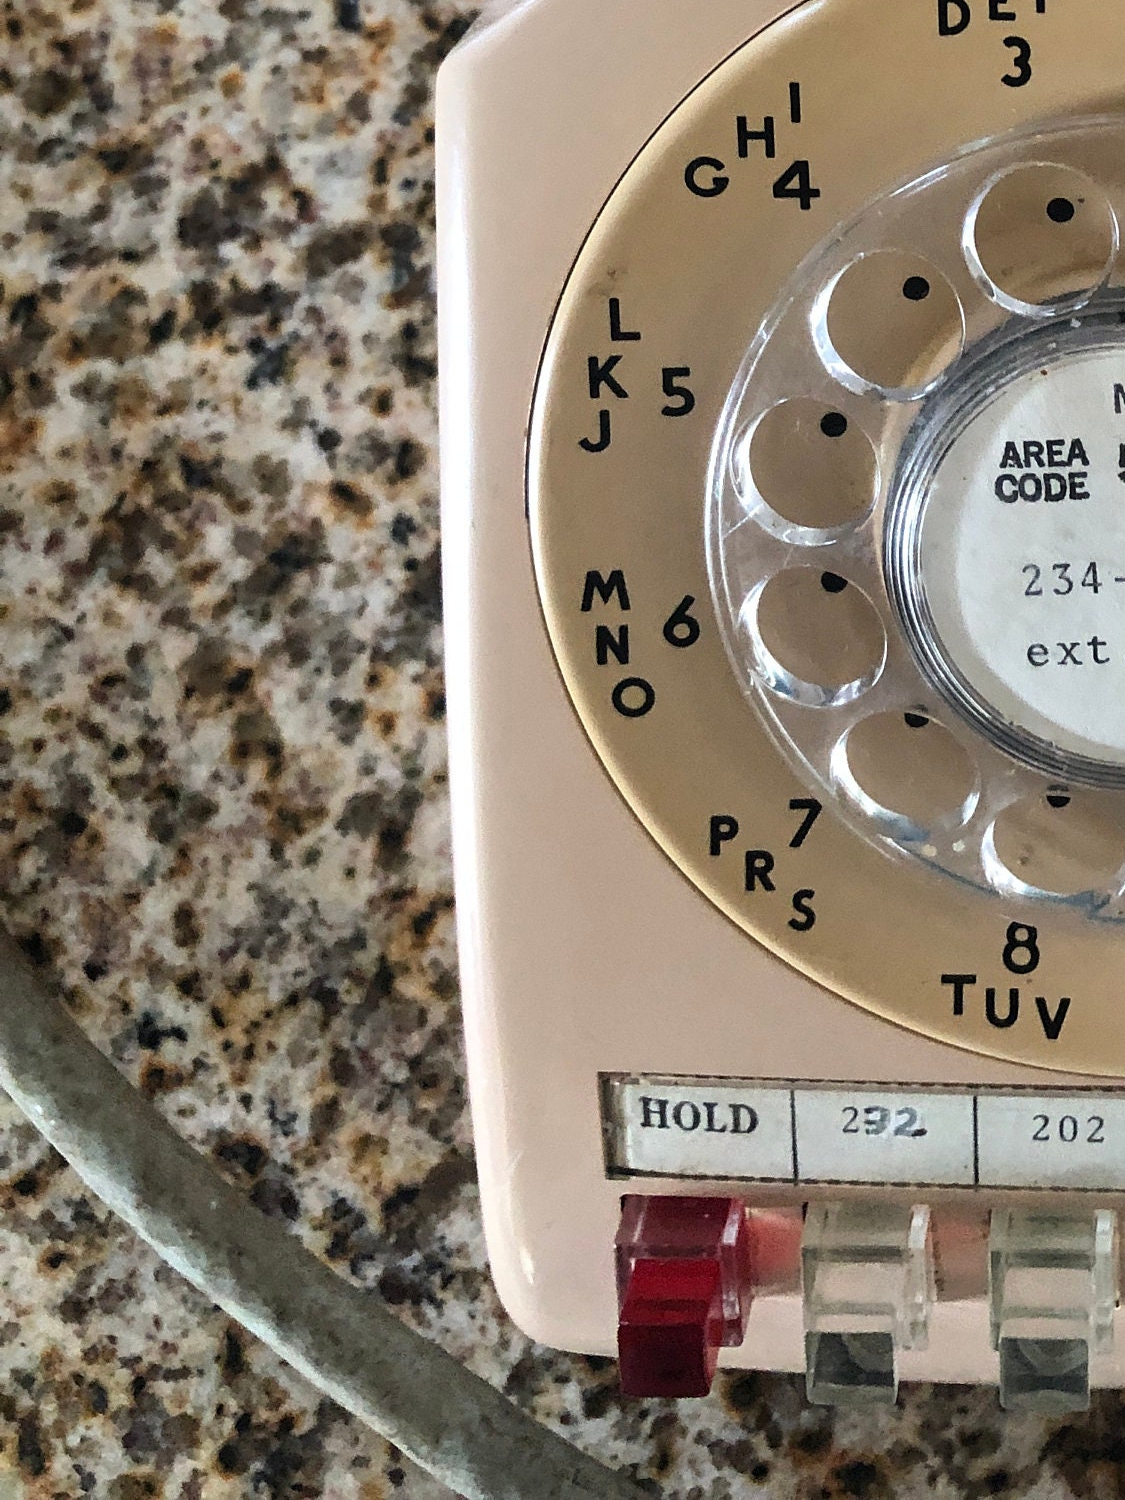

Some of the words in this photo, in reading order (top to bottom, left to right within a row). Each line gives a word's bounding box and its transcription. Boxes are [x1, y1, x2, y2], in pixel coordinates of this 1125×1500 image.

[1000, 36, 1033, 88] 3
[683, 81, 802, 198] GHI
[771, 159, 821, 211] 4
[660, 366, 696, 418] 5
[999, 437, 1090, 469] AREA
[994, 471, 1091, 503] CODE
[662, 595, 701, 648] 6
[788, 798, 823, 849] 7
[708, 814, 817, 932] PRS
[1001, 920, 1041, 976] 8
[940, 973, 1072, 1041] TUV
[639, 1095, 760, 1136] HOLD
[841, 1104, 928, 1139] 232
[1031, 1114, 1107, 1145] 202
